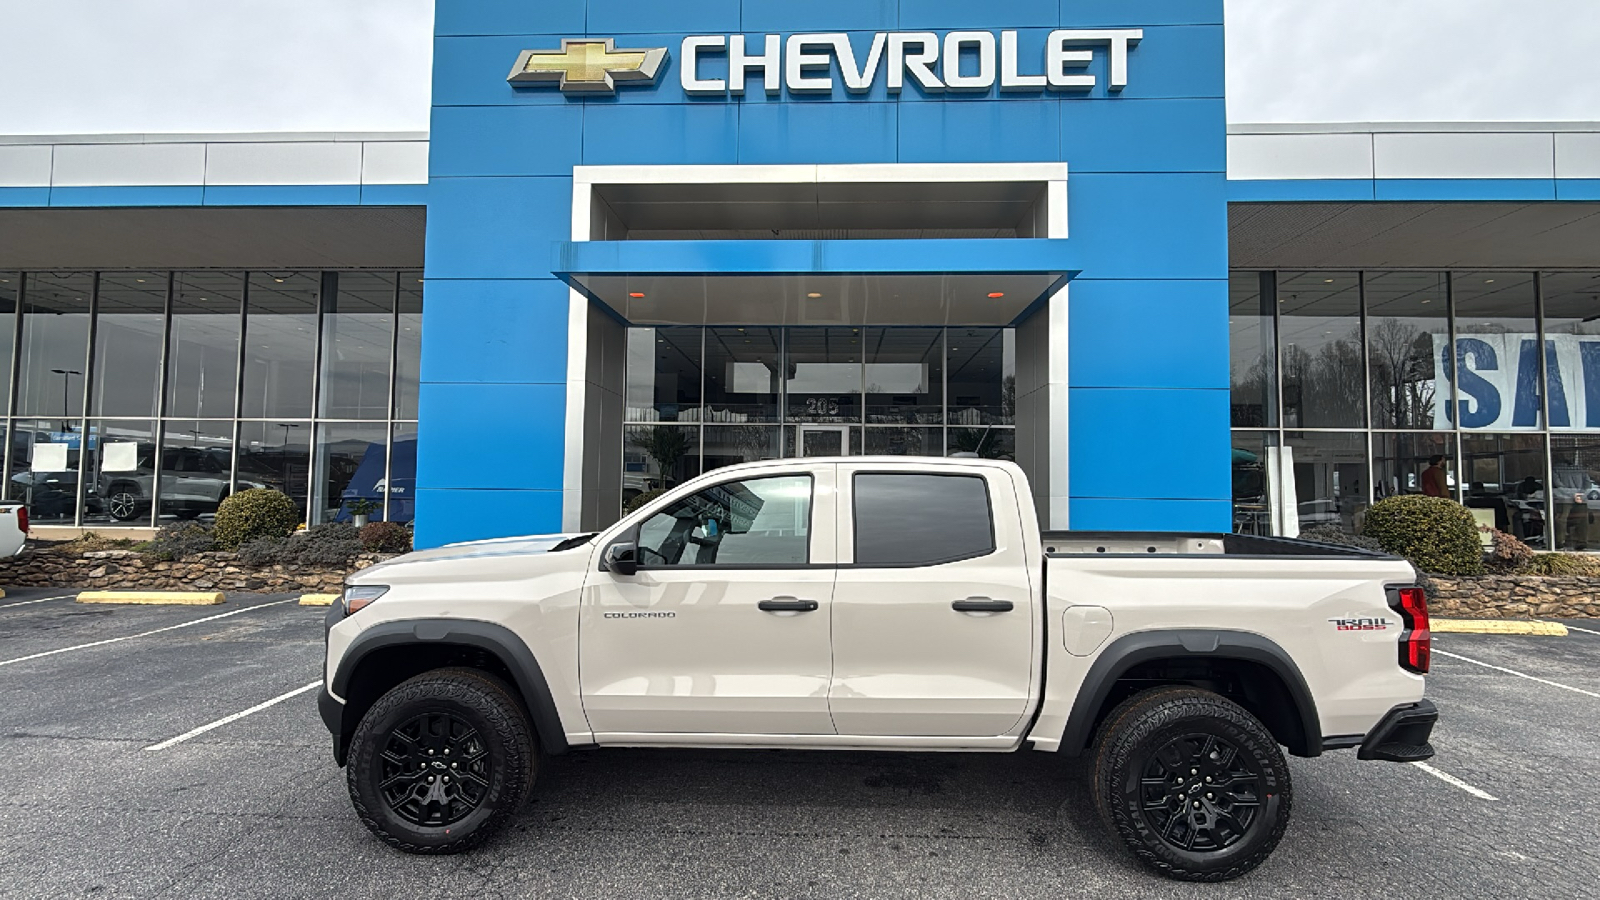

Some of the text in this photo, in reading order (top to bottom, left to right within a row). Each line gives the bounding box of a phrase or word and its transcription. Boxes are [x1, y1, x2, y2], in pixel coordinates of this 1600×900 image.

[680, 28, 1144, 95] CHEVROLET
[806, 397, 839, 415] 205
[1328, 617, 1394, 625] TRAIL
